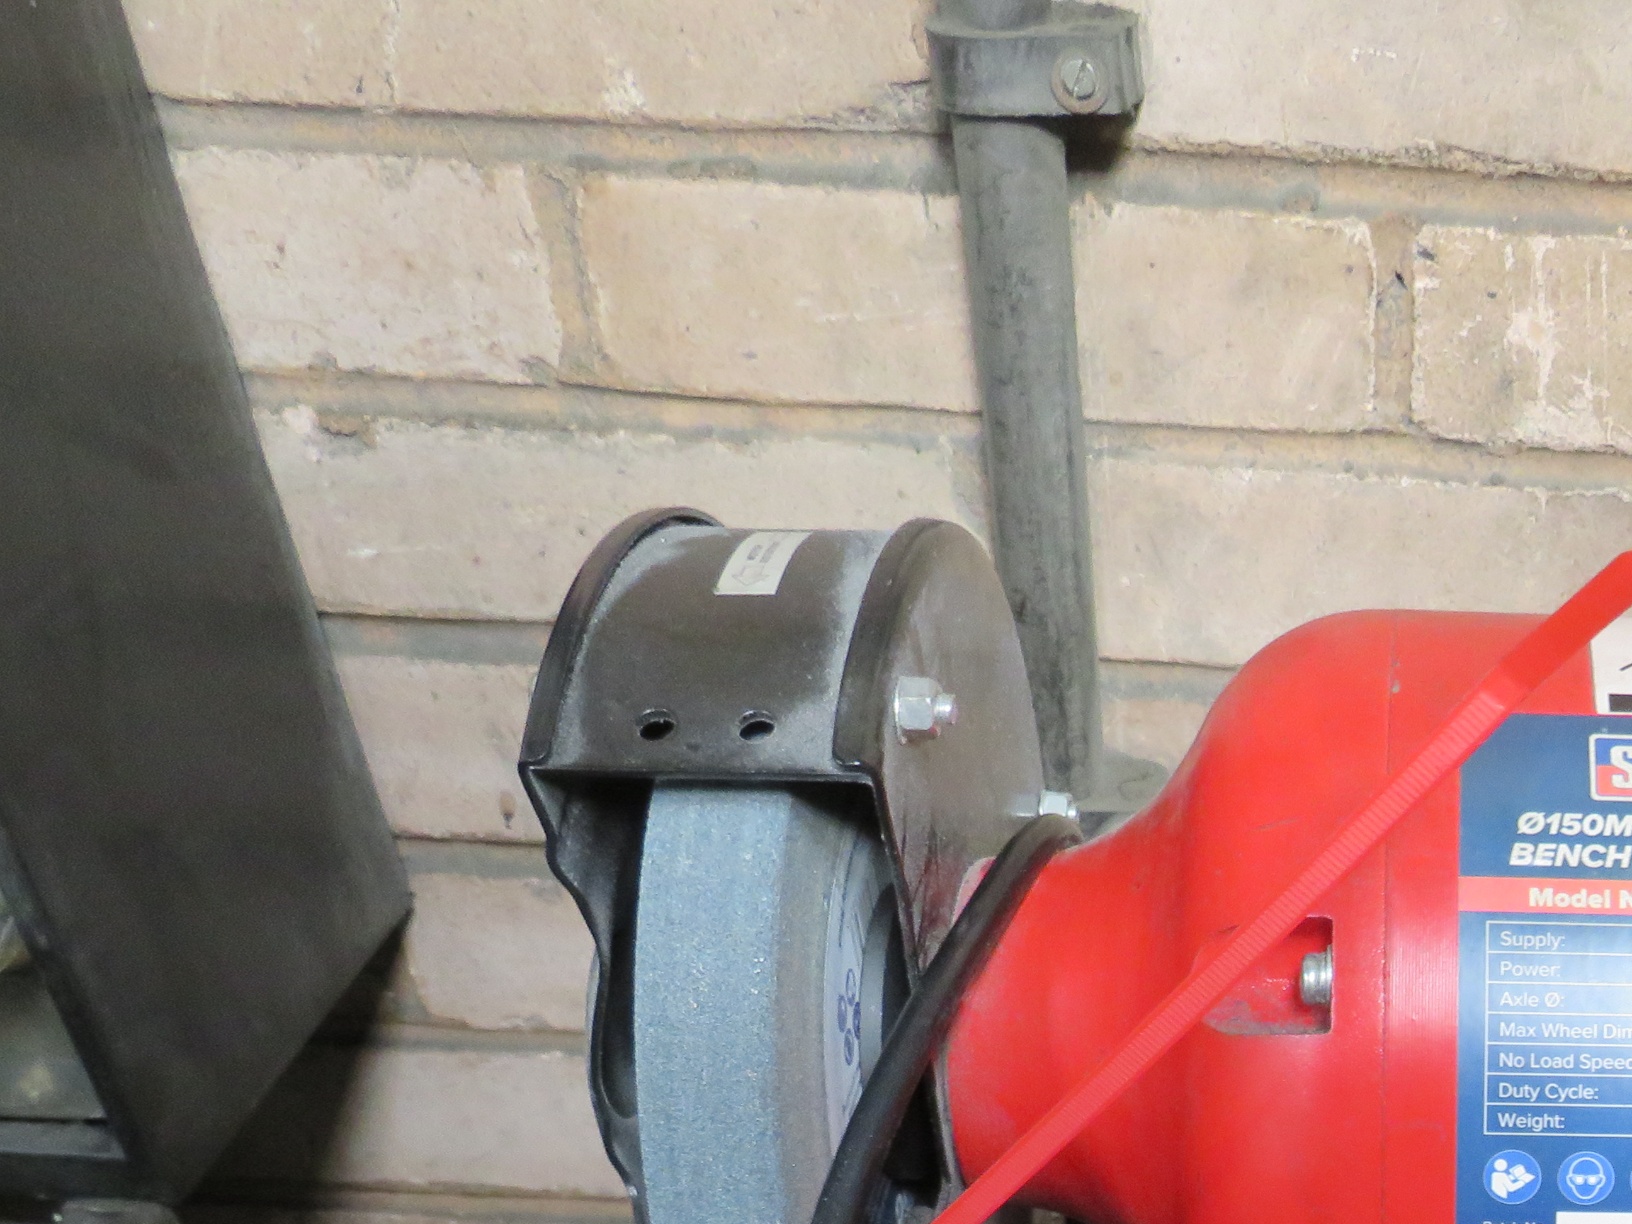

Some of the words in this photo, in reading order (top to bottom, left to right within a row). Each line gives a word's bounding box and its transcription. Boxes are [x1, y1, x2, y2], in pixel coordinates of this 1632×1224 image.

[1509, 843, 1632, 868] BENCH
[1529, 887, 1611, 909] Model
[1500, 931, 1565, 952] Supply:
[1500, 961, 1561, 977] Power:
[1500, 992, 1539, 1008] Axle
[1500, 1023, 1537, 1039] Max
[1541, 1023, 1598, 1039] Wheel
[1499, 1053, 1527, 1069] No
[1530, 1054, 1575, 1069] Load
[1498, 1083, 1541, 1102] Duty
[1545, 1084, 1599, 1102] Cycle:
[1498, 1113, 1565, 1131] Weight:
